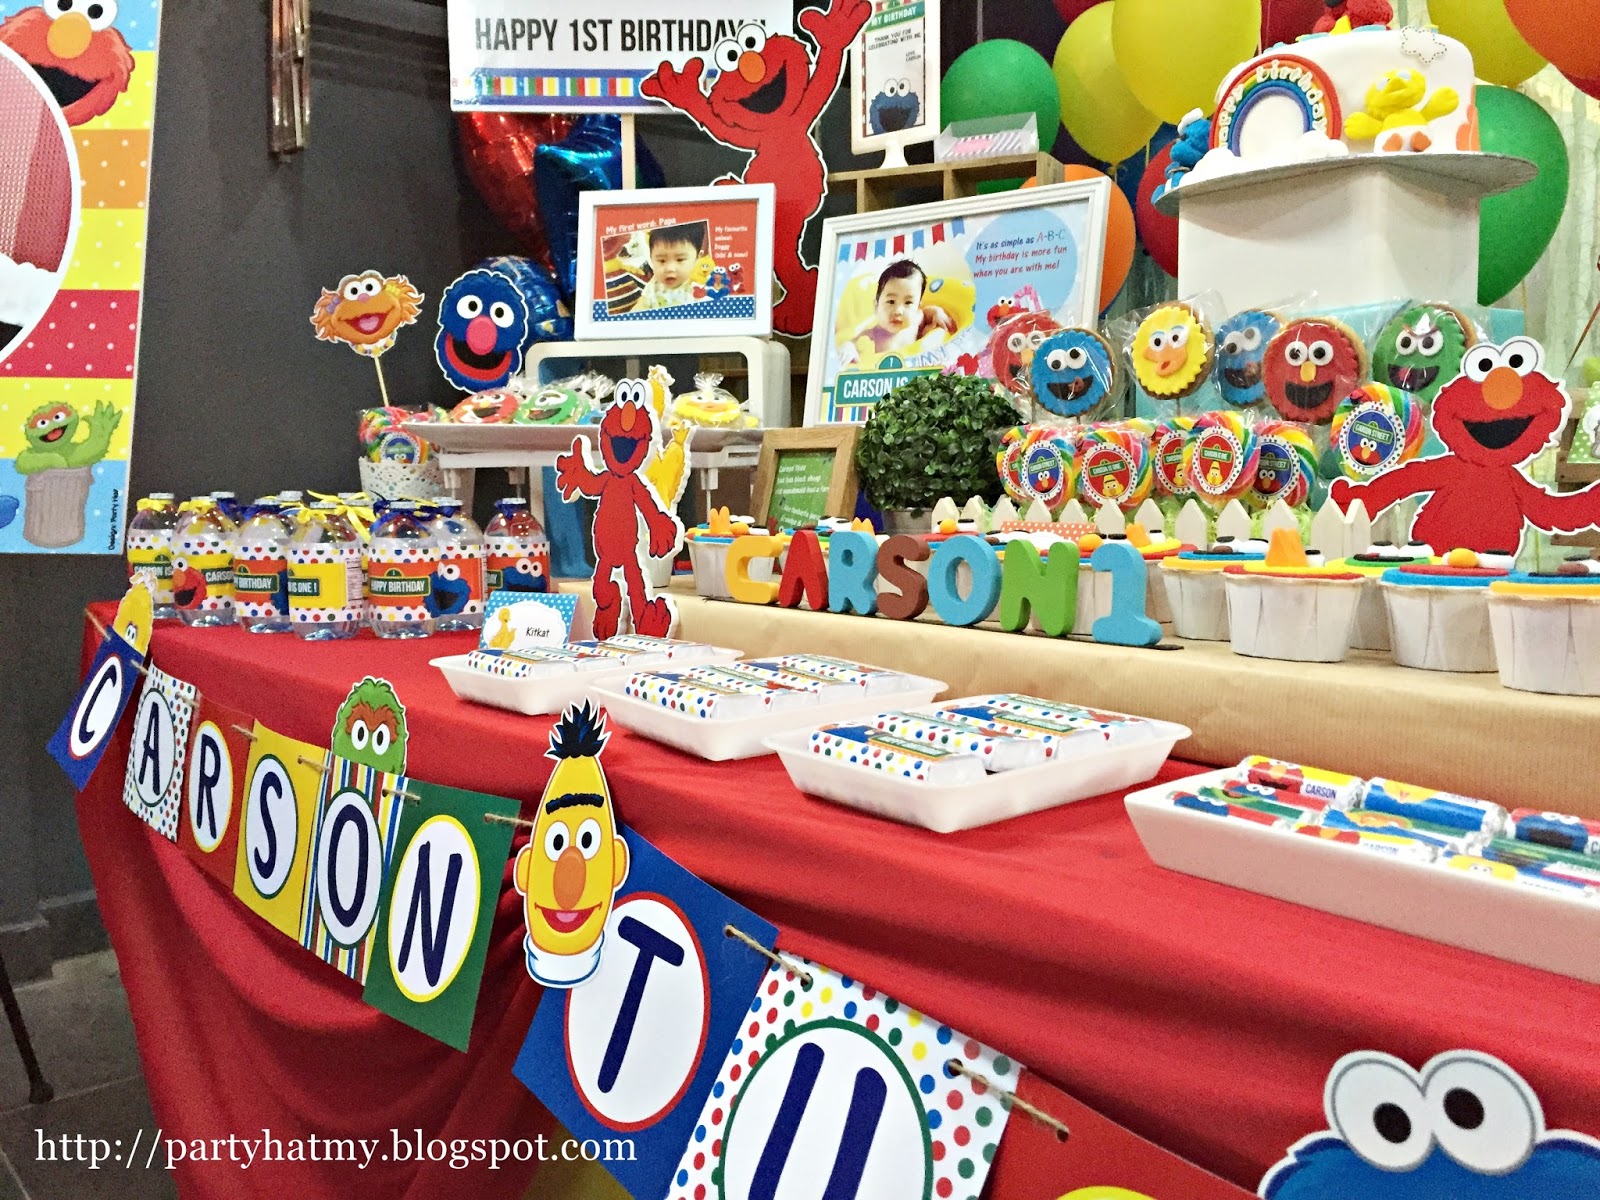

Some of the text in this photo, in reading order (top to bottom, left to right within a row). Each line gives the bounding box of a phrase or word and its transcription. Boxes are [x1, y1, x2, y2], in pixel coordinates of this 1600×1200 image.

[871, 5, 917, 27] MY BIRTHDAY
[475, 17, 558, 51] HAPPY
[569, 18, 613, 52] 1ST
[890, 31, 901, 39] YOU
[1218, 59, 1327, 149] appy birthday
[605, 226, 617, 235] My
[618, 223, 635, 233] first
[658, 217, 677, 227] Papa
[976, 242, 988, 251] It's
[1000, 236, 1024, 249] simple
[975, 244, 1068, 265] My birthday is more fun
[973, 259, 1060, 278] when you are with me!
[843, 377, 893, 399] CARSON
[238, 577, 272, 589] BIRTHDAY
[298, 582, 312, 593] ONE
[388, 580, 425, 593] BIRTHDAY
[725, 530, 1163, 647] CARSON 1
[525, 626, 550, 638] Kitkat
[1305, 783, 1338, 799] CARSON
[78, 663, 463, 988] CARSON
